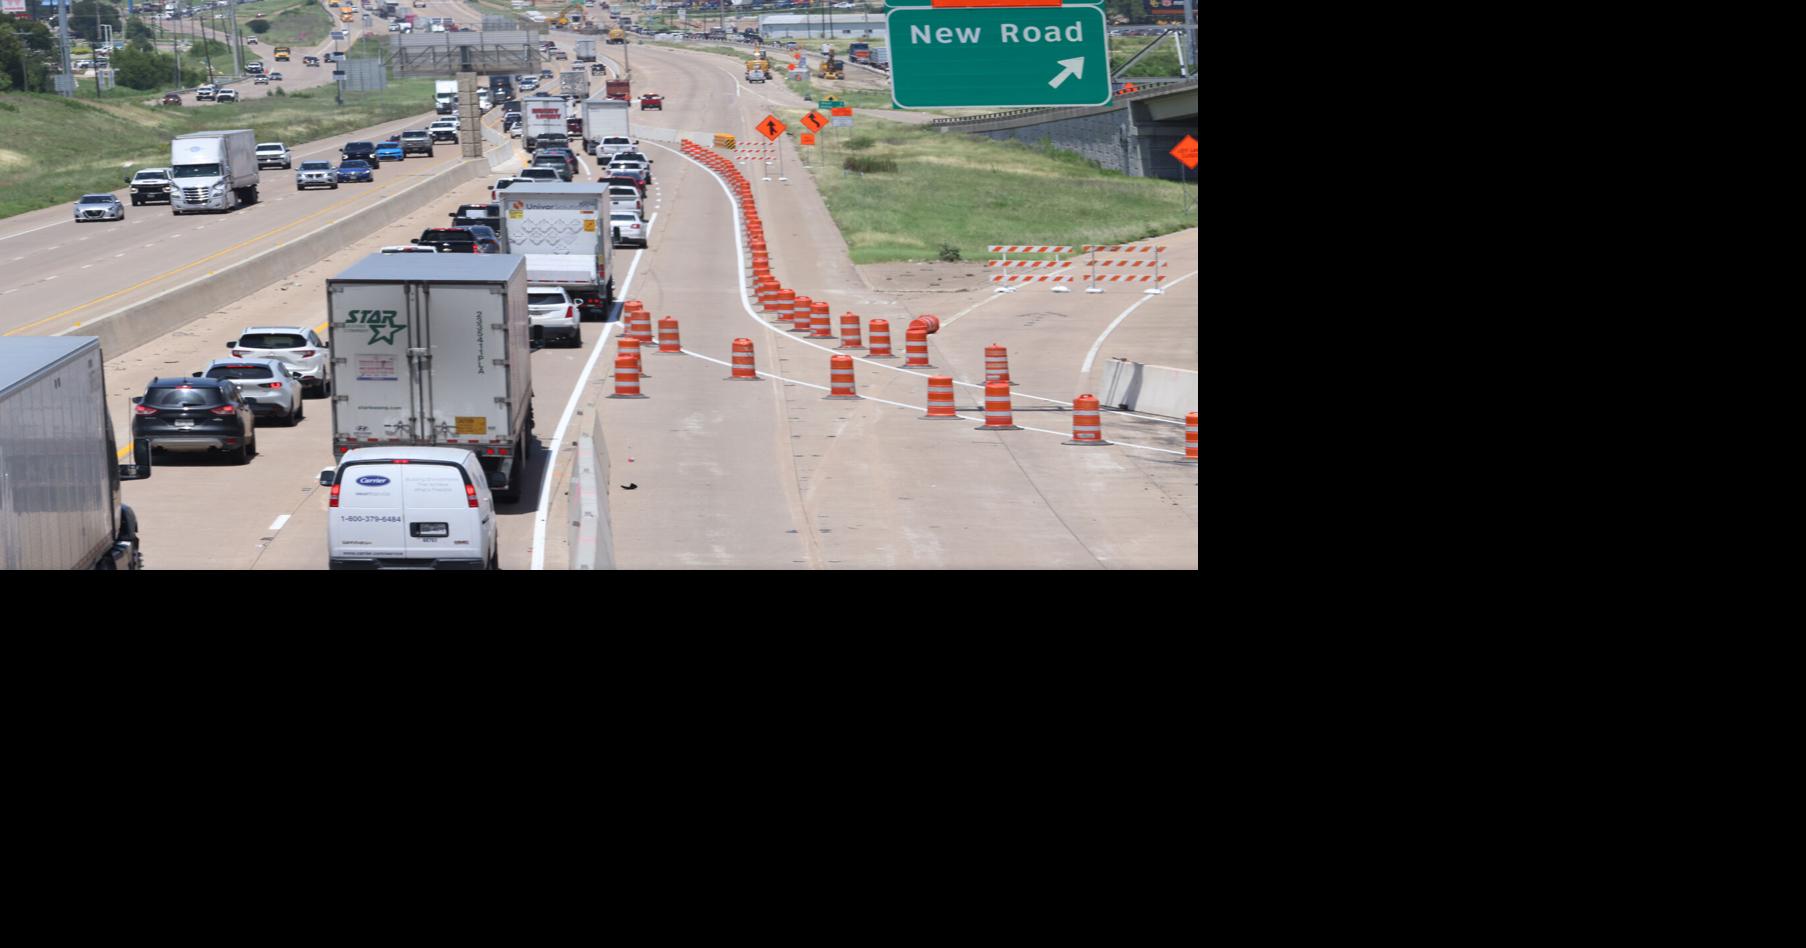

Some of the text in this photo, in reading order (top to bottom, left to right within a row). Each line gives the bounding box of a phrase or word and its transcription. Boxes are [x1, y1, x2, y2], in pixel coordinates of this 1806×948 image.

[910, 21, 1084, 44] New Road
[345, 309, 397, 323] STAR
